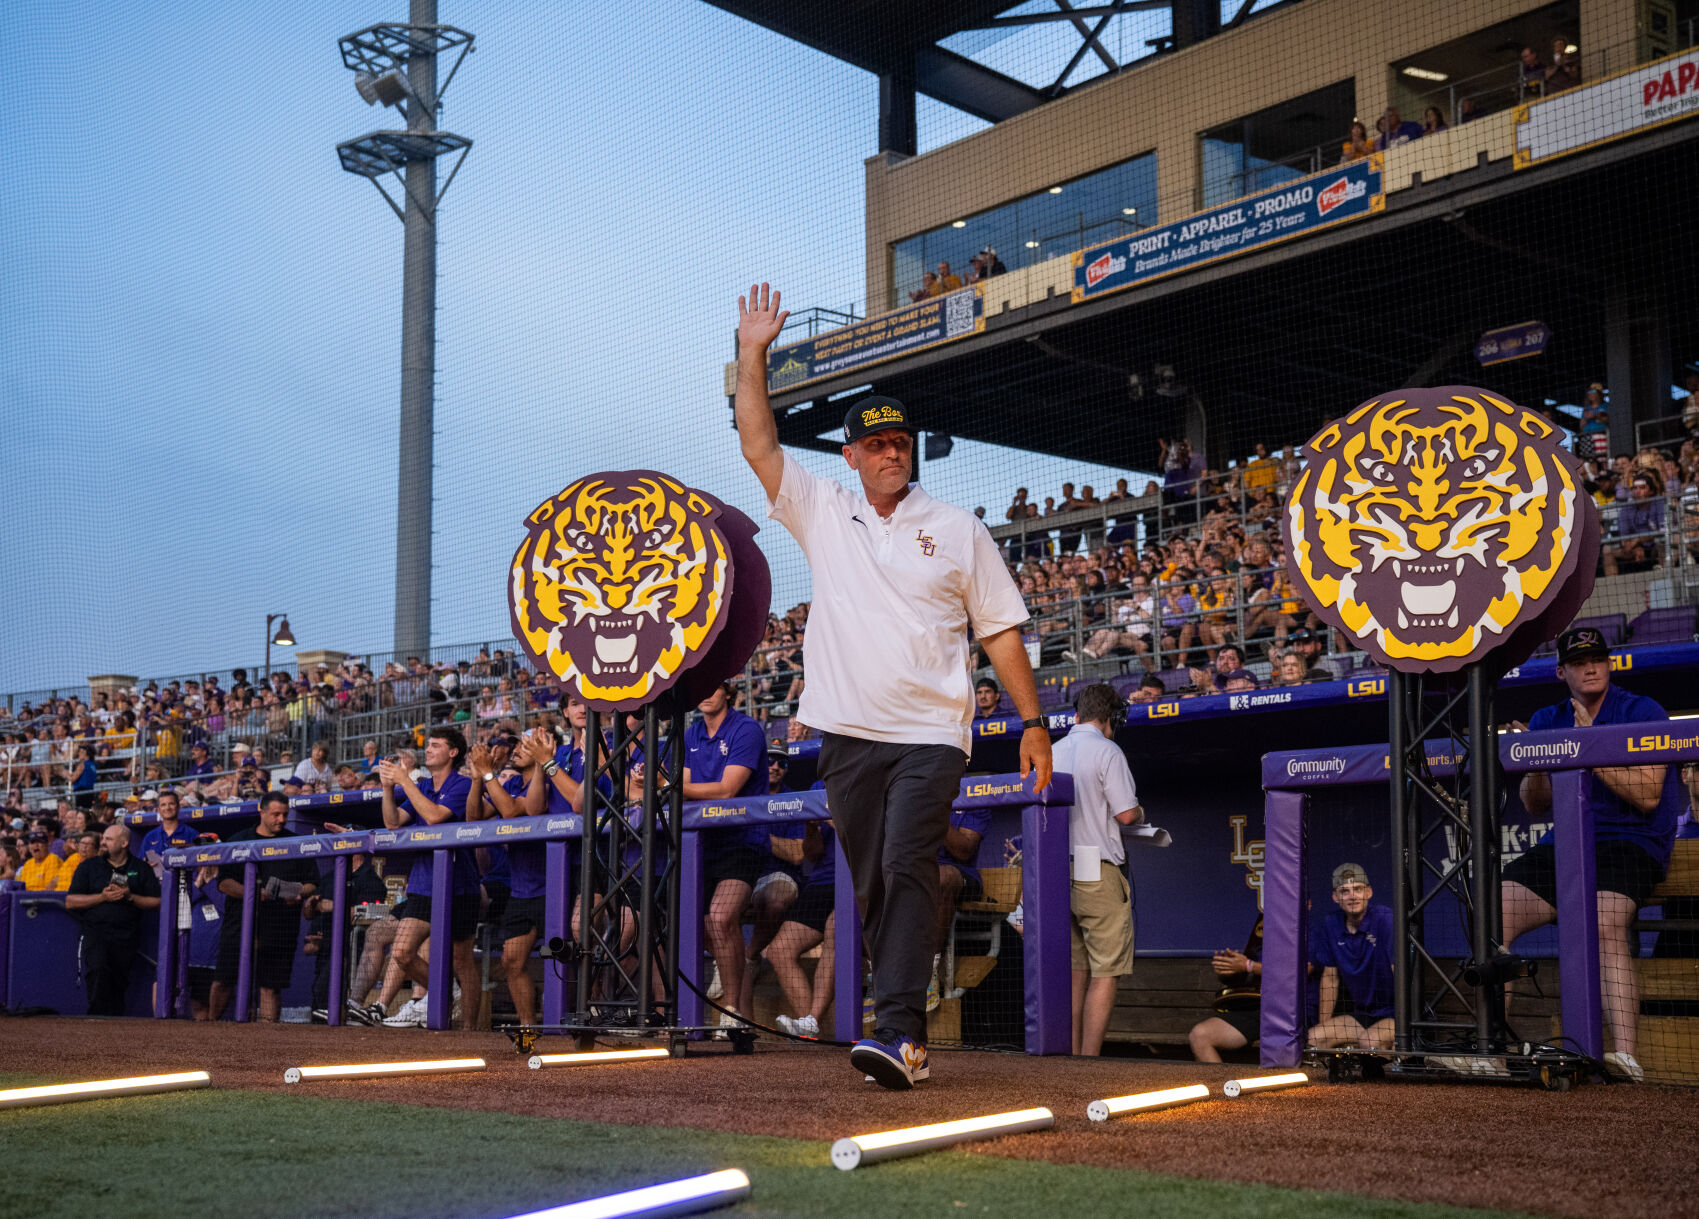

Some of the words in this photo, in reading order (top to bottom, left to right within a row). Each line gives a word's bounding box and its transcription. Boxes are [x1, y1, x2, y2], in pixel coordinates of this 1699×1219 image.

[1129, 231, 1170, 258] PRINT
[1179, 209, 1247, 242] APPAREL
[1255, 186, 1313, 218] PROMO
[1135, 252, 1169, 273] Brands
[1169, 245, 1198, 263] Made
[1199, 233, 1241, 256] Brighter
[1240, 226, 1257, 244] for
[1259, 220, 1273, 234] 25
[1275, 211, 1305, 231] Years
[1525, 331, 1544, 346] 207
[861, 408, 882, 422] The
[881, 406, 903, 418] Box
[915, 529, 937, 557] LSU
[1608, 653, 1633, 672] SU
[1348, 679, 1385, 698] LSU
[1250, 692, 1292, 708] RENTALS
[1148, 702, 1180, 719] LSU
[979, 721, 1007, 737] LSU
[1510, 739, 1581, 762] Community
[1287, 756, 1347, 777] Community
[1529, 758, 1561, 766] COFFEE
[966, 782, 1023, 797] LSUsports.net
[329, 793, 343, 804] LSU
[768, 797, 804, 814] Community
[192, 808, 204, 819] LSU
[702, 806, 746, 819] LSUsports.net
[547, 818, 576, 832] Community
